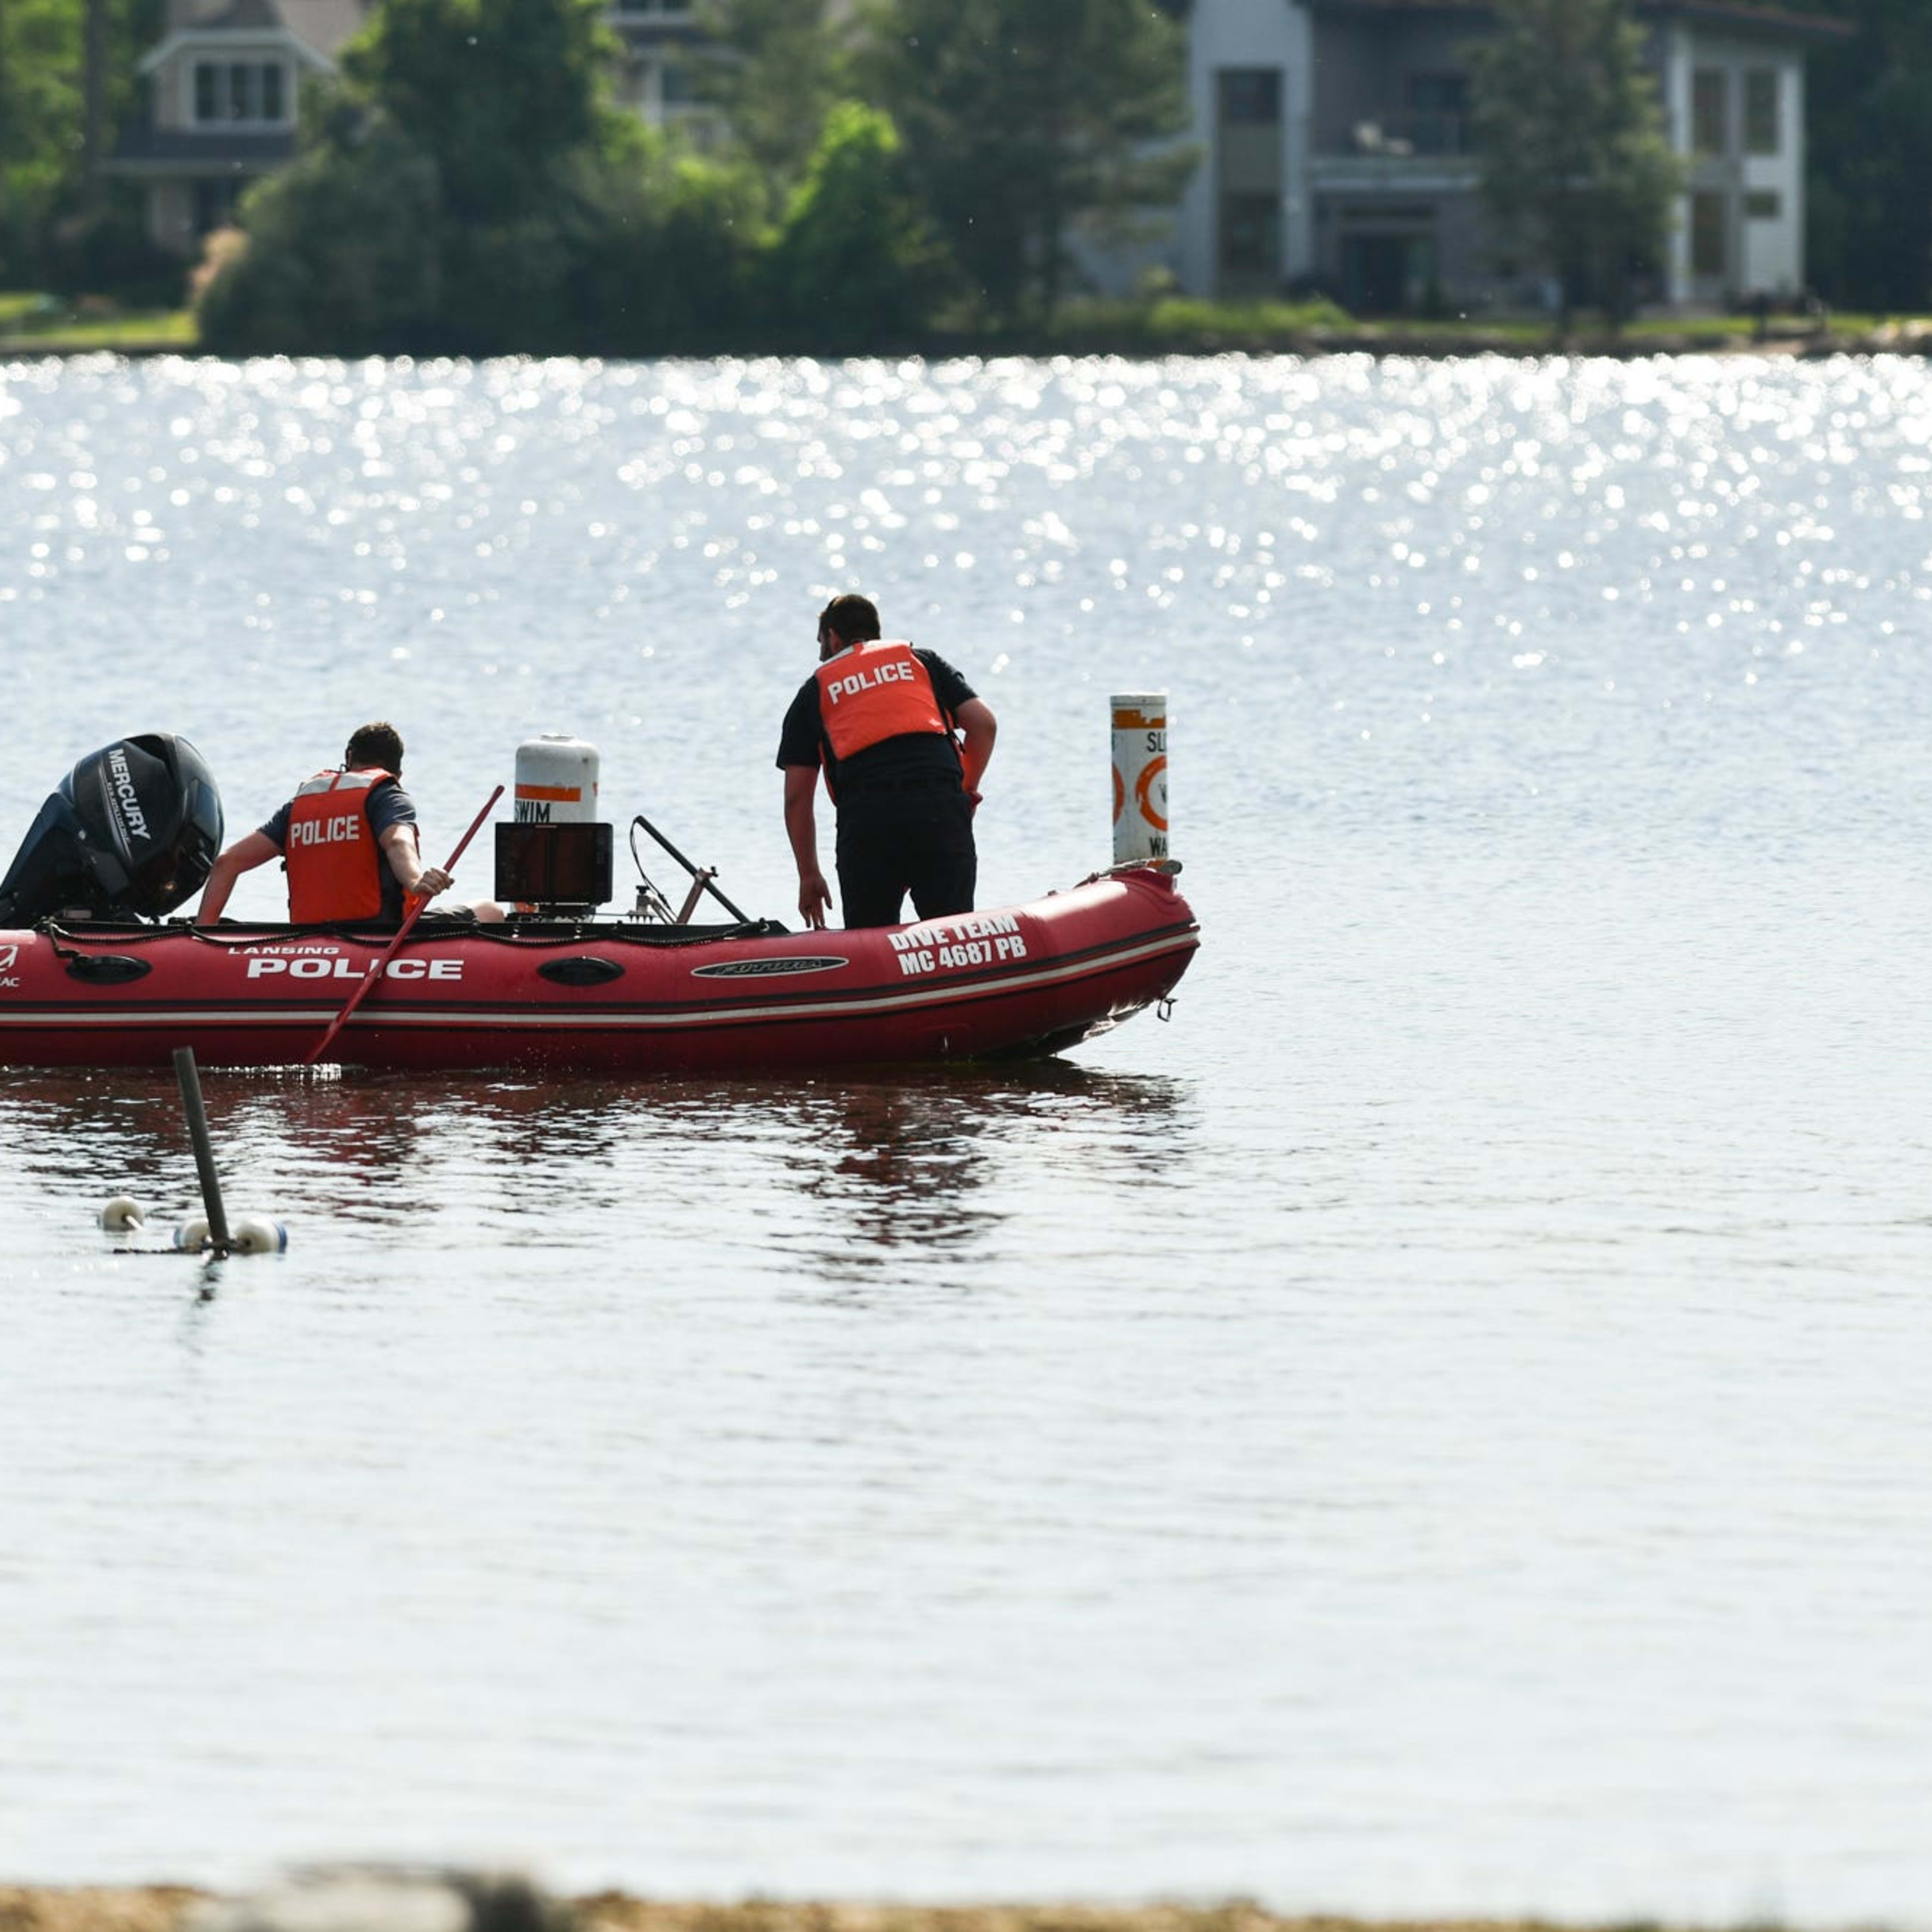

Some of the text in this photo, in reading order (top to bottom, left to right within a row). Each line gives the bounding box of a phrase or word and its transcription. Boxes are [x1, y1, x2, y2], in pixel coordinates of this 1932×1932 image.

[827, 661, 915, 705] POLICE
[1147, 732, 1166, 752] SL
[108, 748, 151, 839] MERCURY
[291, 816, 359, 848] POLICE
[887, 915, 1020, 951] DIVE TEAM
[898, 935, 1027, 975] MC 4687 PB
